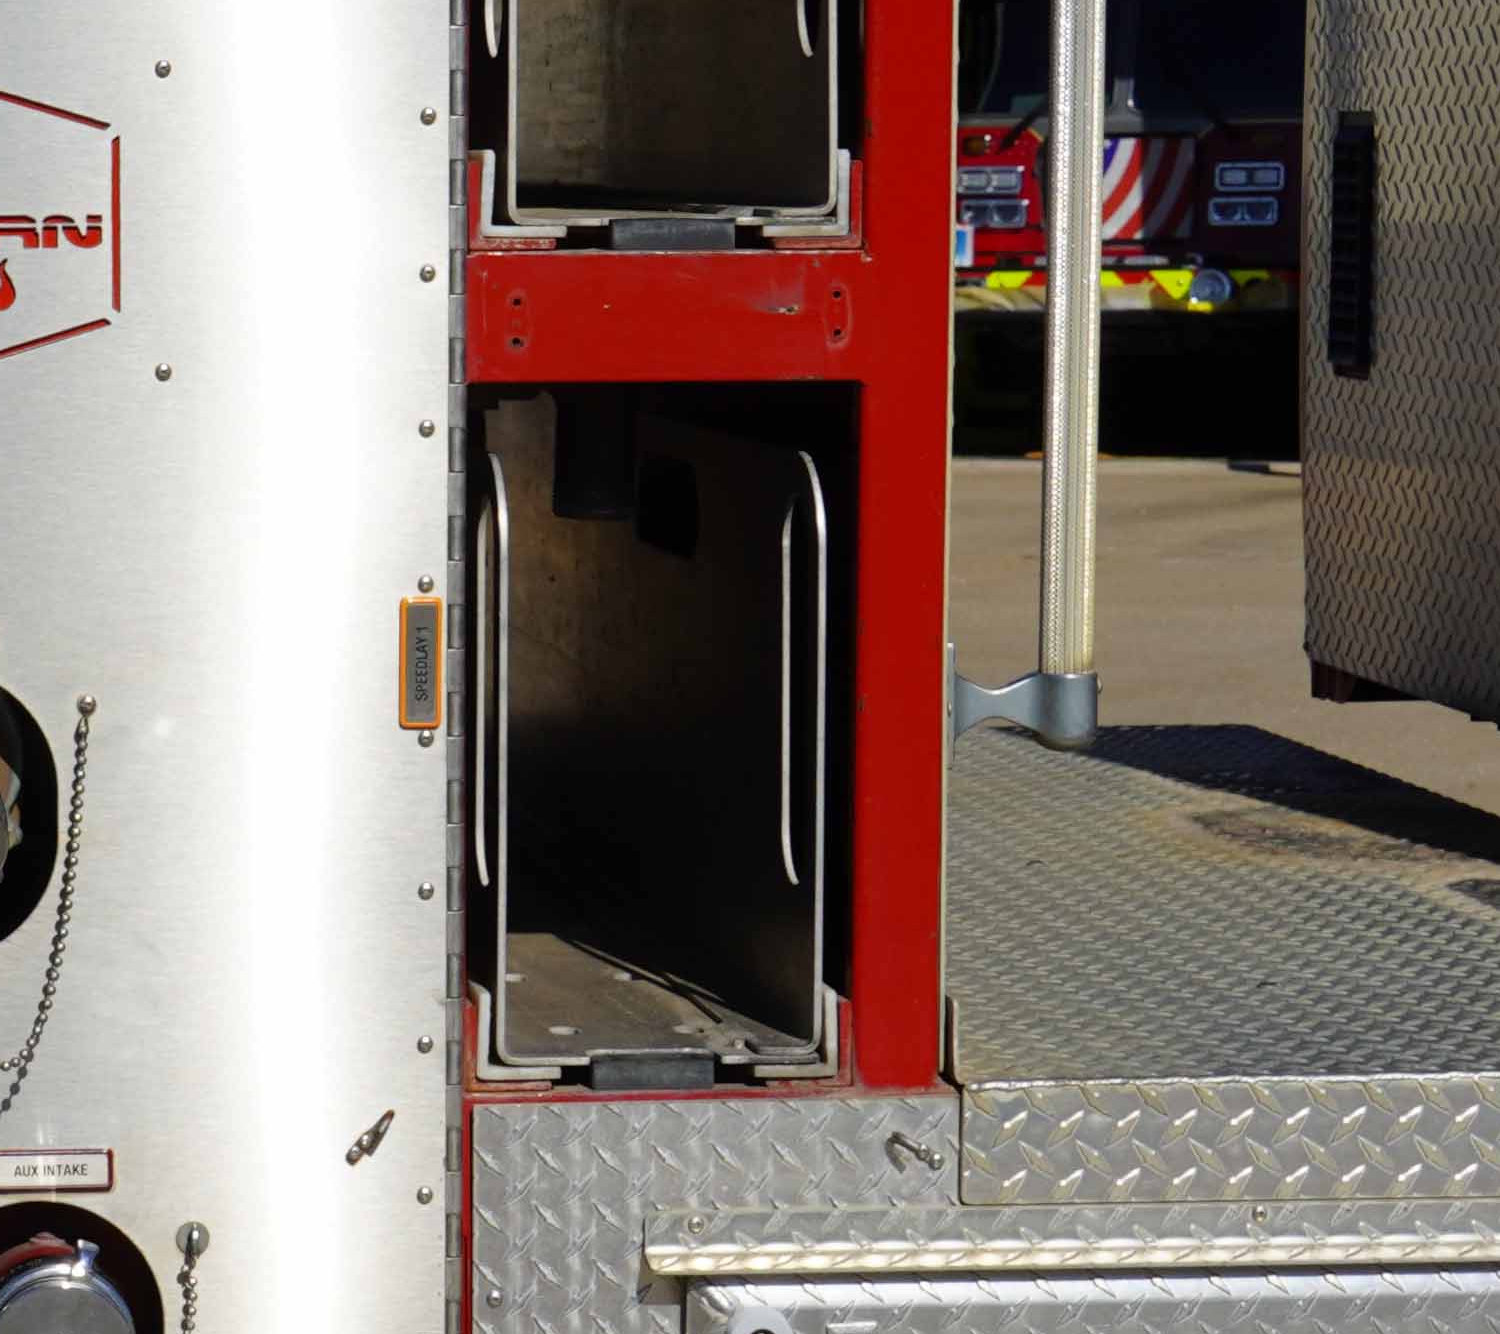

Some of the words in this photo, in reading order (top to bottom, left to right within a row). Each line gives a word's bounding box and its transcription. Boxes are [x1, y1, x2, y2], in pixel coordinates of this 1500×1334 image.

[414, 639, 430, 701] SPEEDLAY
[14, 1165, 39, 1177] AUX
[43, 1163, 88, 1176] INTAKE
